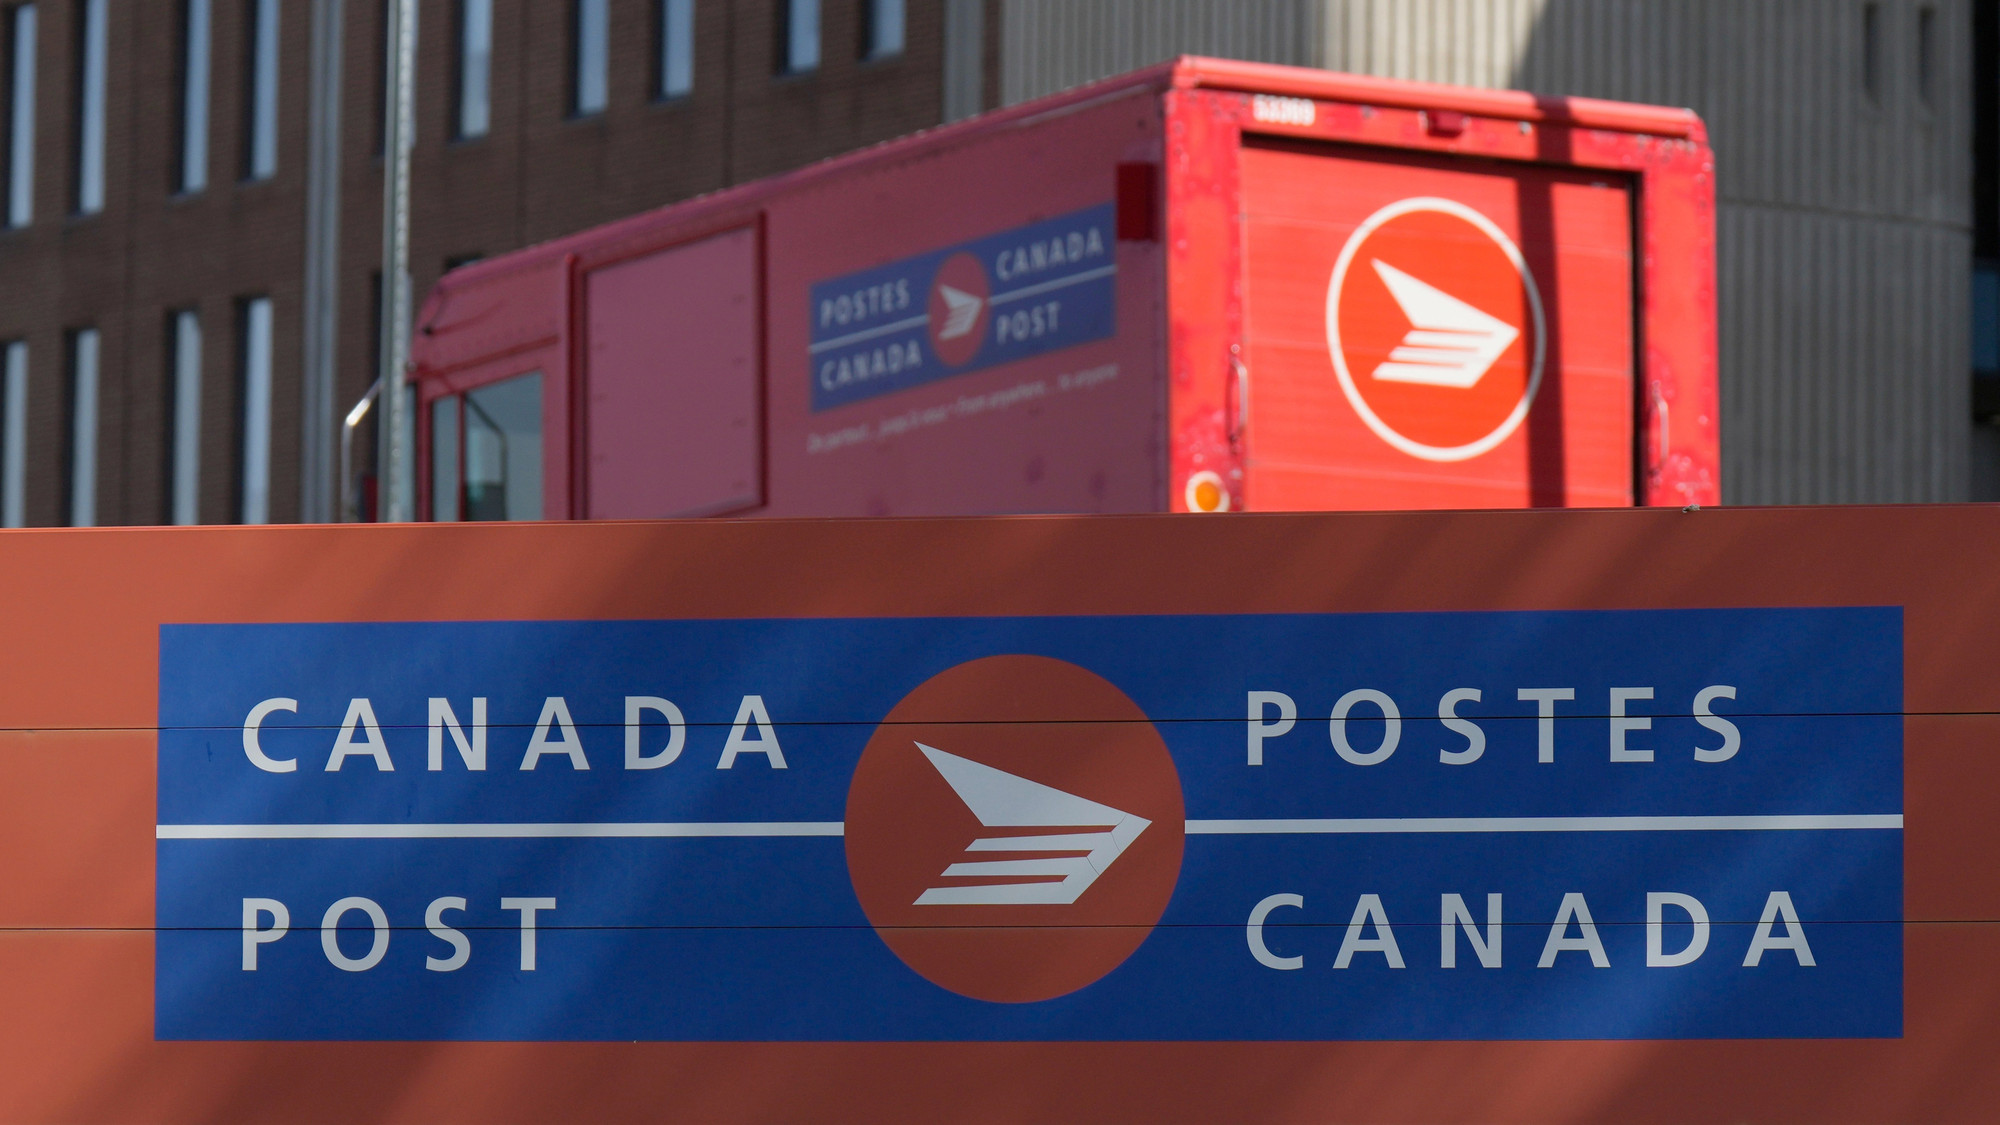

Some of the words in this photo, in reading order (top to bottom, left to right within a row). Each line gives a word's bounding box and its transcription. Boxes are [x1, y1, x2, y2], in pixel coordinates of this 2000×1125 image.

[996, 227, 1104, 281] CANADA
[820, 278, 910, 328] POSTES
[996, 301, 1061, 344] POST
[820, 339, 922, 391] CANADA
[242, 695, 788, 773] CANADA
[1246, 685, 1741, 766] POSTES
[242, 896, 557, 972] POST
[1246, 891, 1817, 970] CANADA
